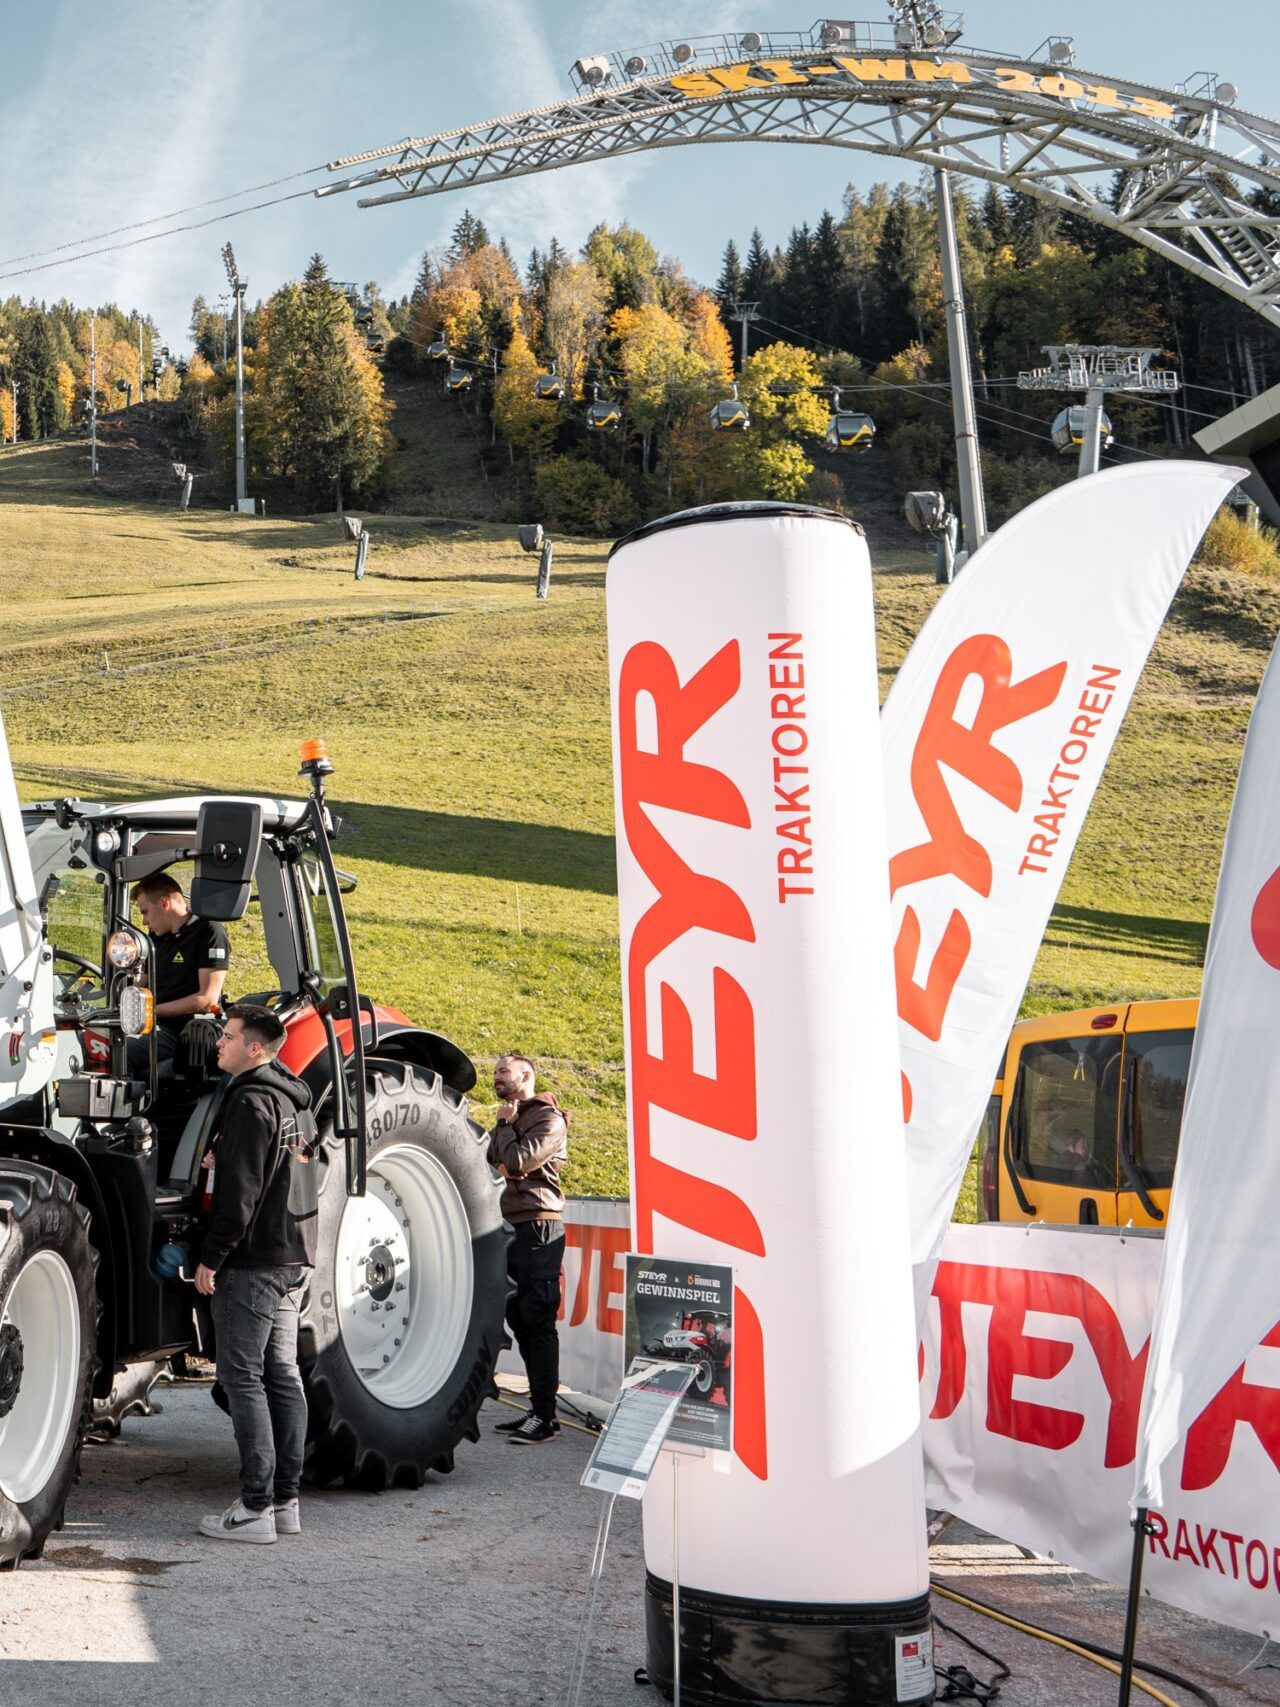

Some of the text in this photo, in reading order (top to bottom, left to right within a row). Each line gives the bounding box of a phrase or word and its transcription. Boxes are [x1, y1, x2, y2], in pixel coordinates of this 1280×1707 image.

[671, 56, 1175, 119] SKI-WM 2013
[768, 632, 815, 904] TRAKTOREN
[1018, 664, 1122, 877] TRAKTOREN
[637, 1283, 720, 1303] GEWINNSPIEL
[638, 1270, 668, 1281] STEYR
[1147, 1509, 1280, 1595] RAKTO
